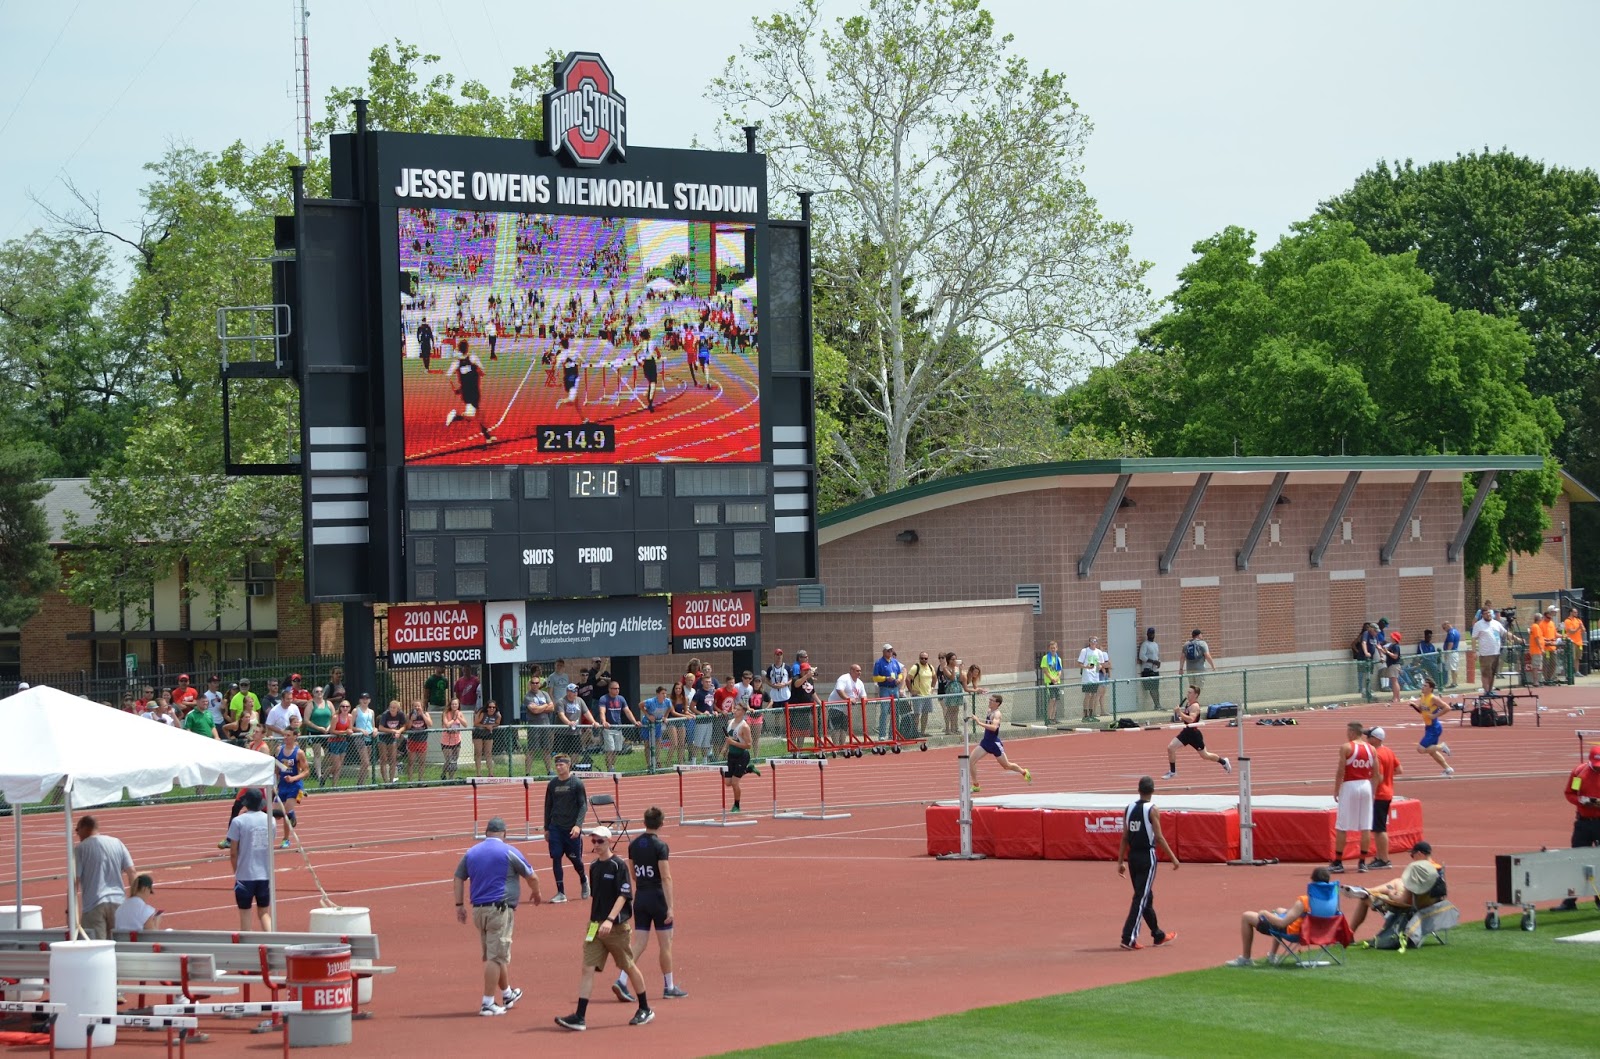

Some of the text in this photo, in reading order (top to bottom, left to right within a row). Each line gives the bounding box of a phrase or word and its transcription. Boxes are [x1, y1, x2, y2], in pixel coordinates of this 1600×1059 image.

[551, 84, 625, 157] OHIO STATE
[395, 168, 758, 214] JESSE OWENS MEMORIAL STADIUM
[543, 430, 606, 449] 2:14.9
[576, 470, 618, 496] 12:18
[522, 548, 554, 565] SHOTS
[578, 547, 613, 564] PERIOD
[637, 545, 668, 561] SHOTS
[685, 598, 743, 614] 2007 NCAA
[404, 609, 468, 626] 2010 NCAA
[678, 612, 751, 630] COLLEGE CUP
[395, 625, 479, 643] COLLEGE CUP
[530, 619, 575, 637] Athletes
[577, 617, 617, 638] Helping
[683, 635, 747, 650] MEN'S SOCCER
[392, 649, 481, 665] WOMEN'S SOCCER
[1085, 817, 1124, 829] UCS
[634, 864, 655, 878] 315
[212, 1005, 245, 1013] UCS
[124, 1018, 151, 1026] UCS
